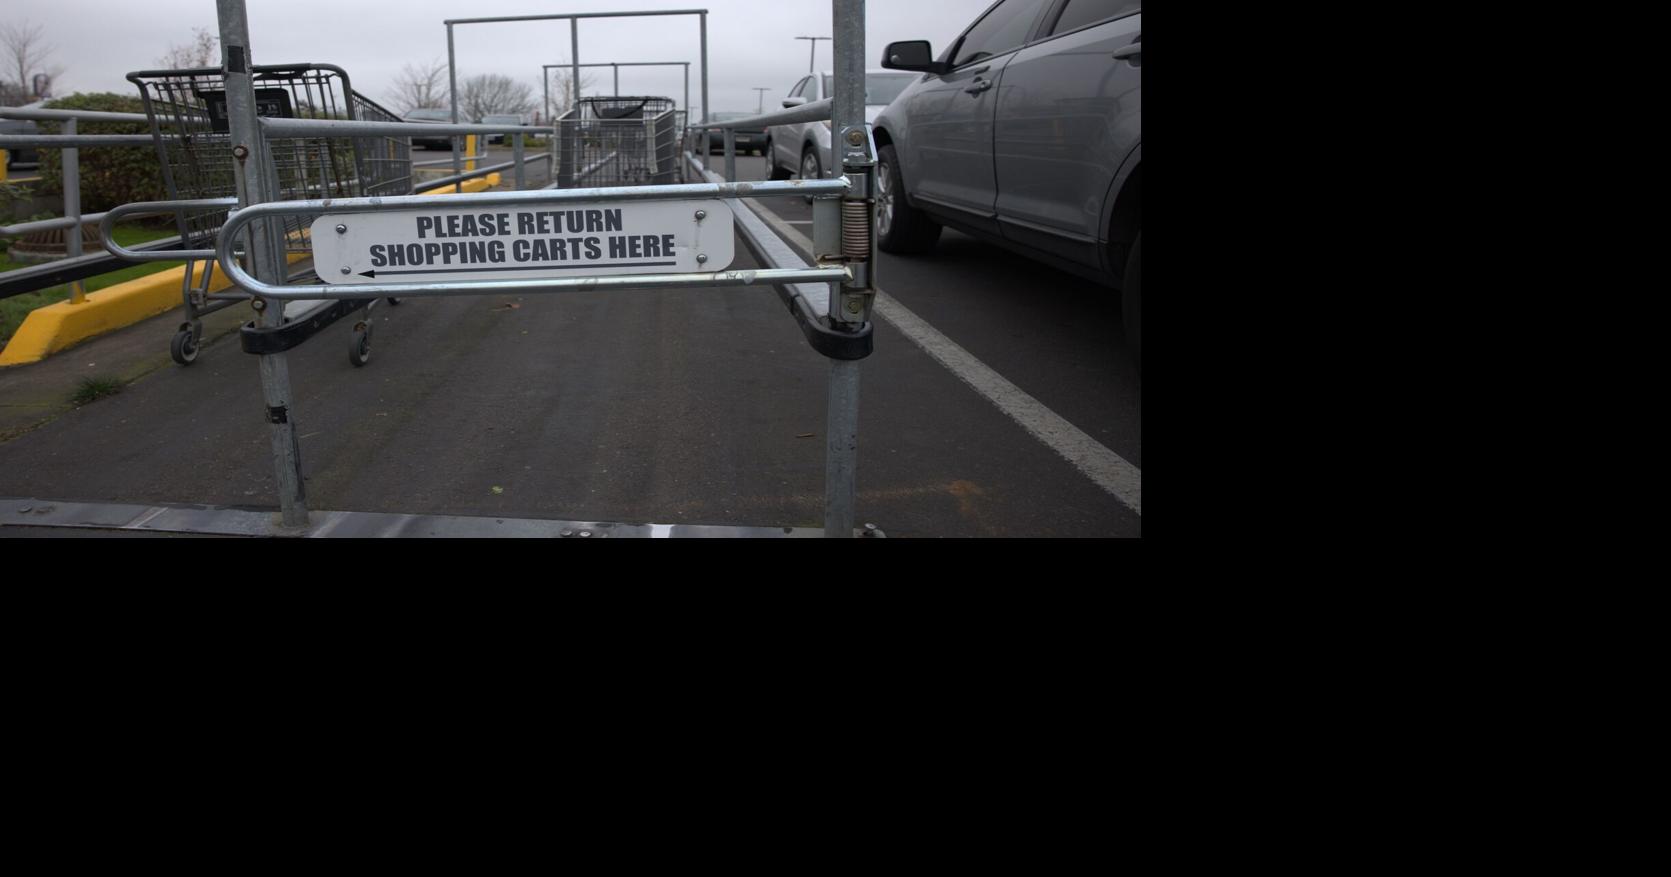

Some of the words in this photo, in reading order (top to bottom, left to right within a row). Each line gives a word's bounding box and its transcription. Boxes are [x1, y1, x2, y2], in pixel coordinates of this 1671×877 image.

[416, 213, 511, 238] PLEASE
[517, 209, 622, 235] RETURN
[370, 241, 506, 267] SHOPPING
[513, 237, 602, 263] CARTS
[609, 235, 676, 259] HERE
